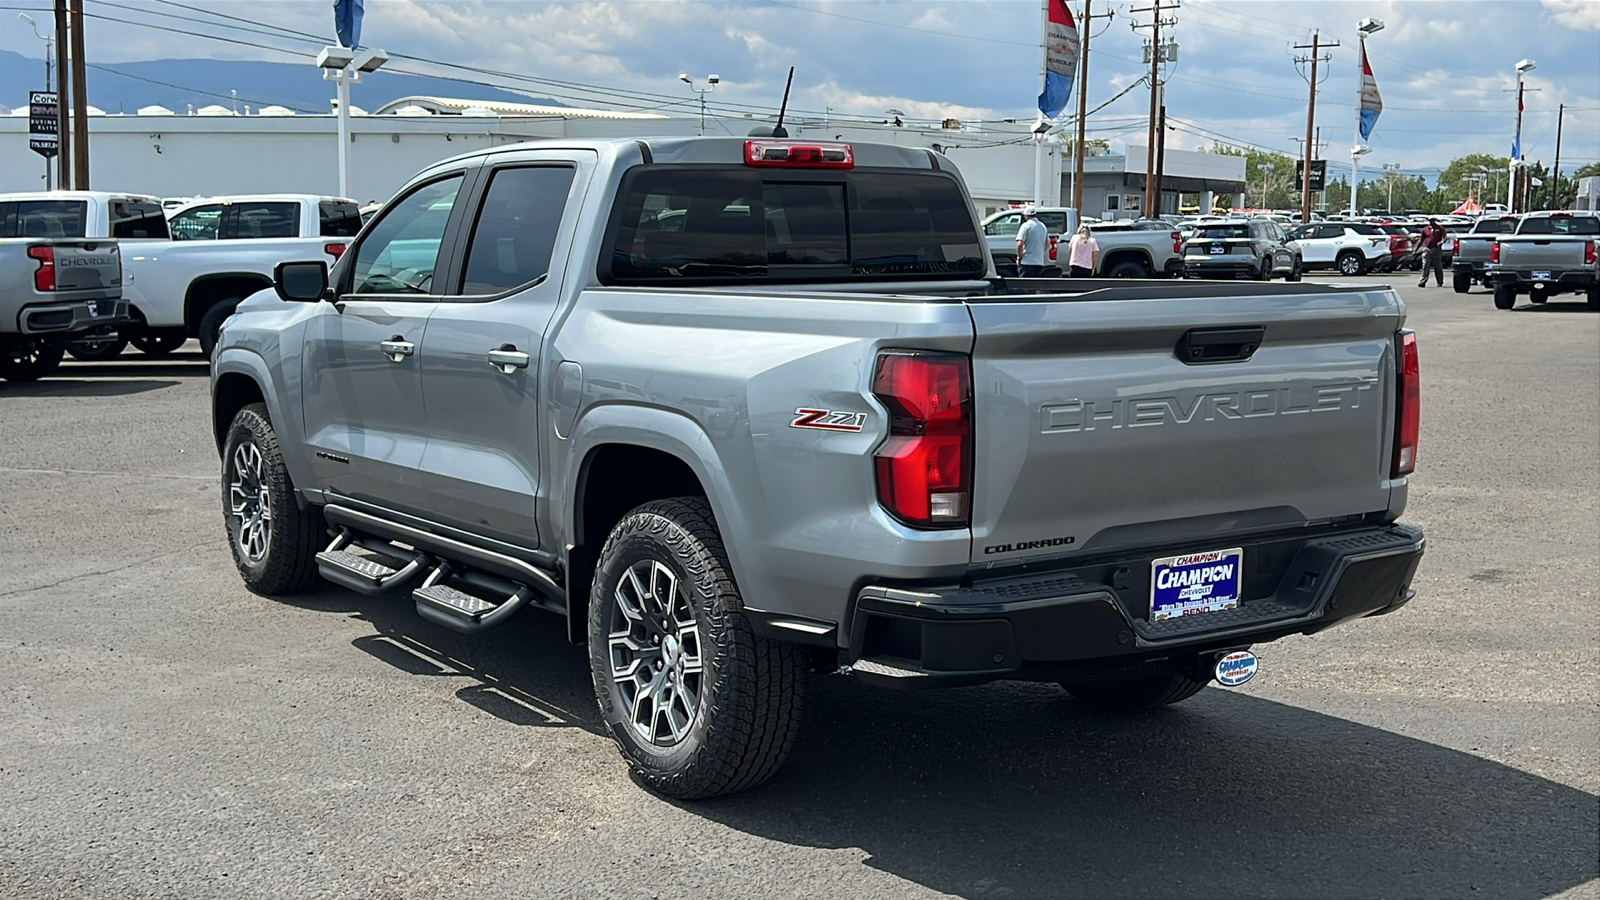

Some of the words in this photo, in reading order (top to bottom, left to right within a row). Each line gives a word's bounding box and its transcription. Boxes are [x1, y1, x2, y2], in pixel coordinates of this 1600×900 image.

[60, 257, 117, 267] CHEVROLET
[1039, 380, 1375, 434] CHEVROLET
[789, 407, 868, 433] Z71
[984, 536, 1075, 555] COLORADO
[1176, 552, 1220, 566] CHAMPION
[1156, 564, 1234, 590] CHAMPION
[1181, 586, 1211, 597] CHEVROLET
[1182, 606, 1211, 616] RENO
